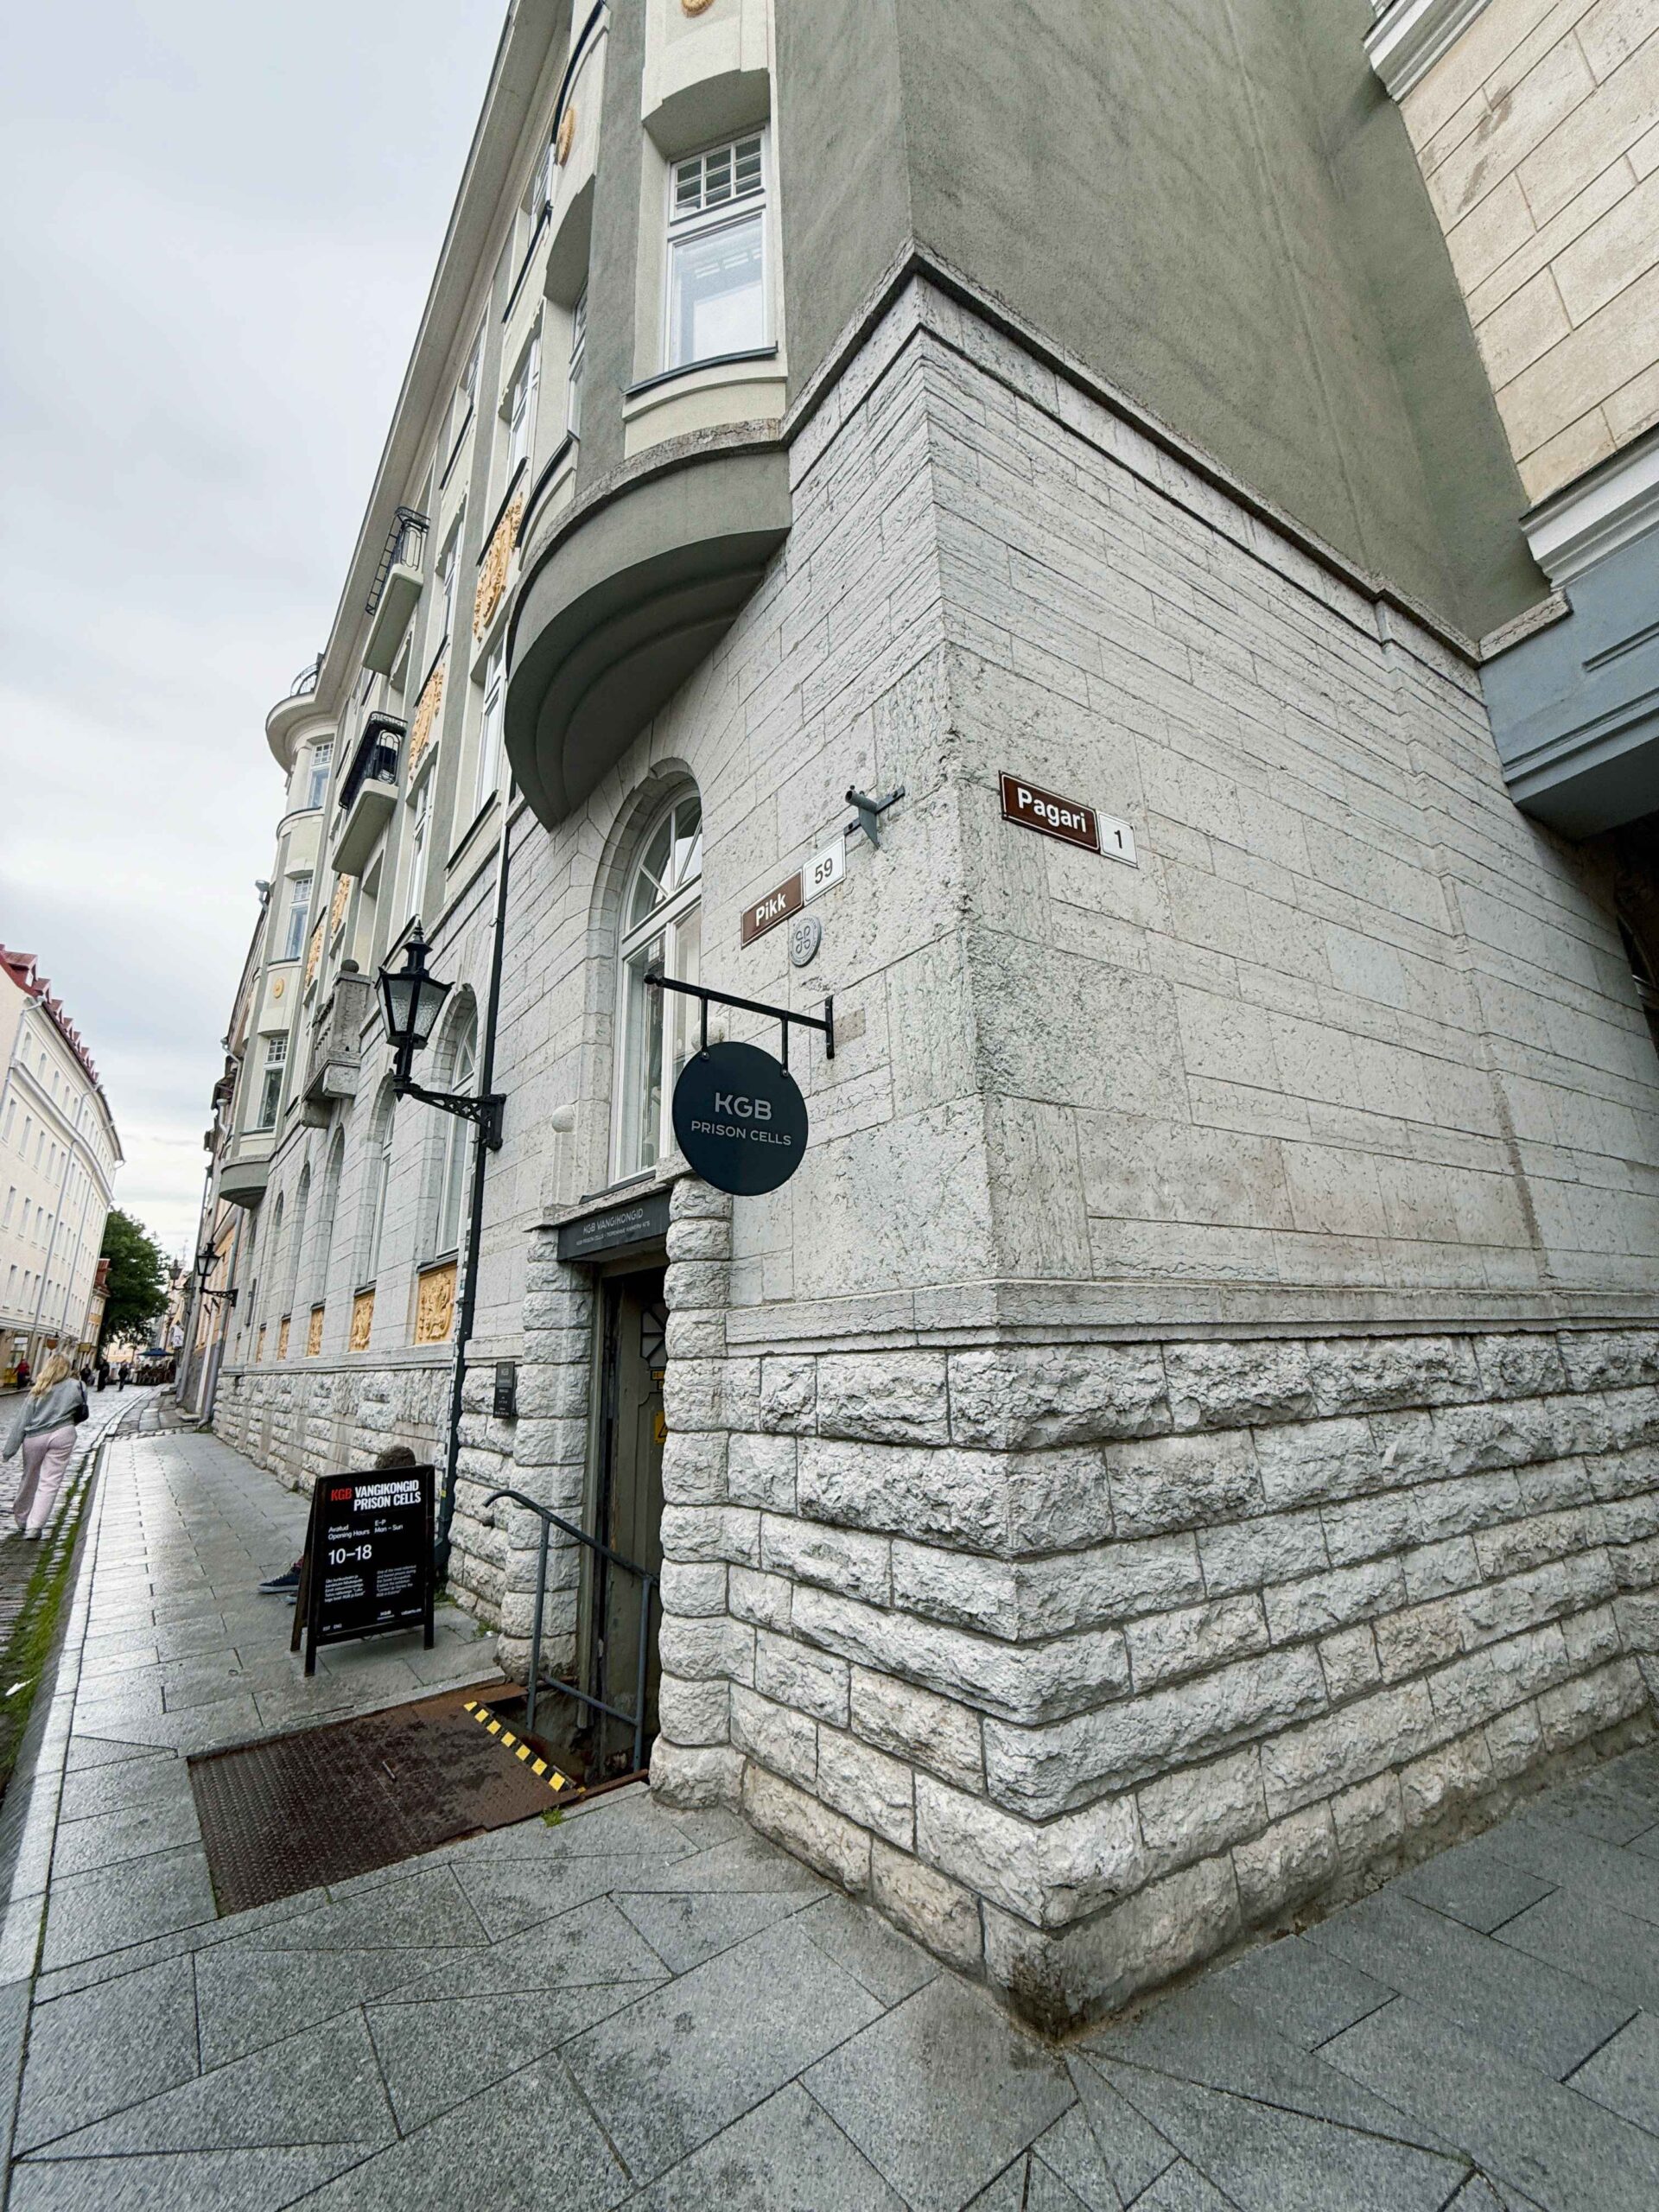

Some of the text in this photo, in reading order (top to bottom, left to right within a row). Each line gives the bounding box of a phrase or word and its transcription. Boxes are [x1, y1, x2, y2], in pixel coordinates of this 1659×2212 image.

[1017, 787, 1087, 833] Pagari
[1114, 830, 1122, 849] 1
[815, 858, 833, 885] 59
[755, 893, 786, 927] Pikk
[715, 1092, 772, 1121] KGB
[691, 1121, 792, 1146] PRISON CELLS
[331, 1479, 420, 1502] KGB VANGIKONGID
[353, 1491, 422, 1511] PRISON CELLS
[328, 1528, 370, 1541] Opening Hours
